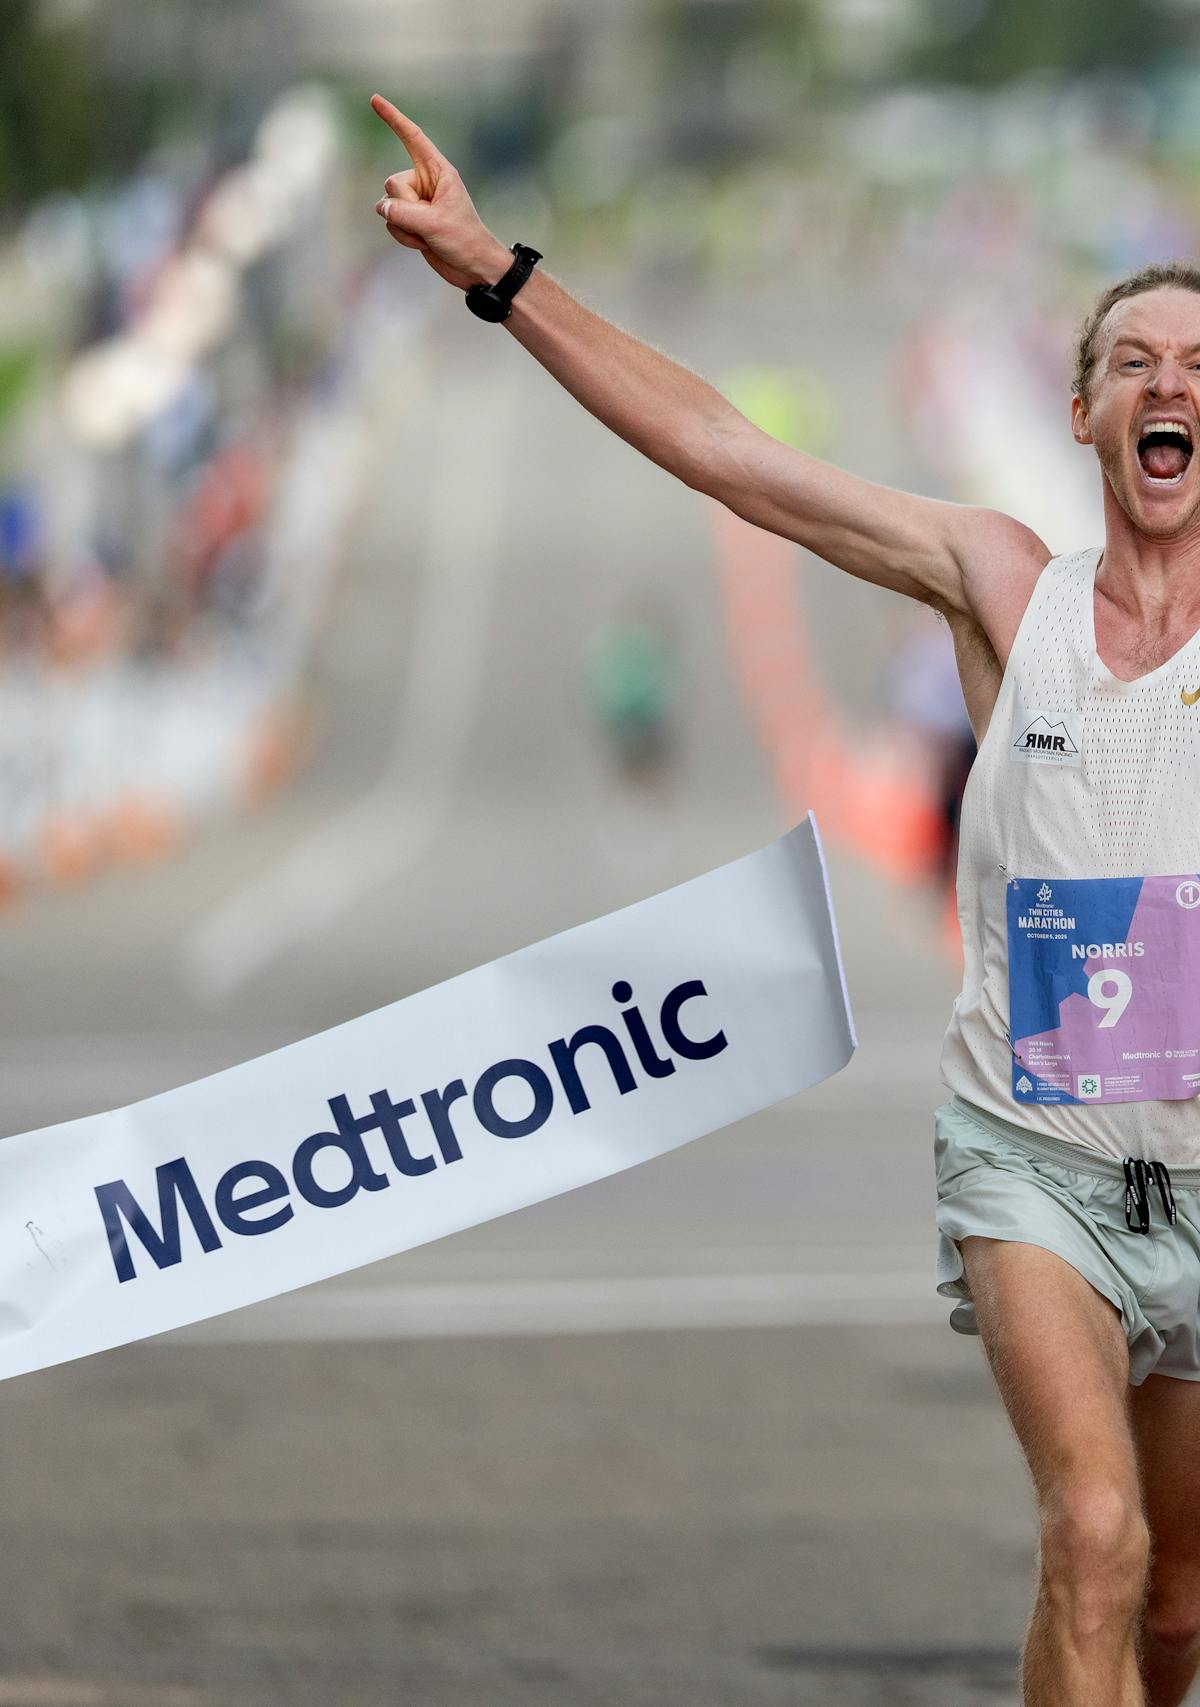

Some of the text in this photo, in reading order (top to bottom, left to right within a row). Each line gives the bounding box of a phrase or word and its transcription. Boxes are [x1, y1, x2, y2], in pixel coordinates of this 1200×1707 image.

[1028, 908, 1064, 917] TWIN CITIES
[1018, 916, 1076, 930] MARATHON
[1026, 932, 1050, 940] OCTOBER
[1071, 941, 1145, 959] NORRIS
[1087, 968, 1133, 1029] 9
[1122, 1050, 1161, 1060] Medtronic
[94, 979, 729, 1284] Medtronic
